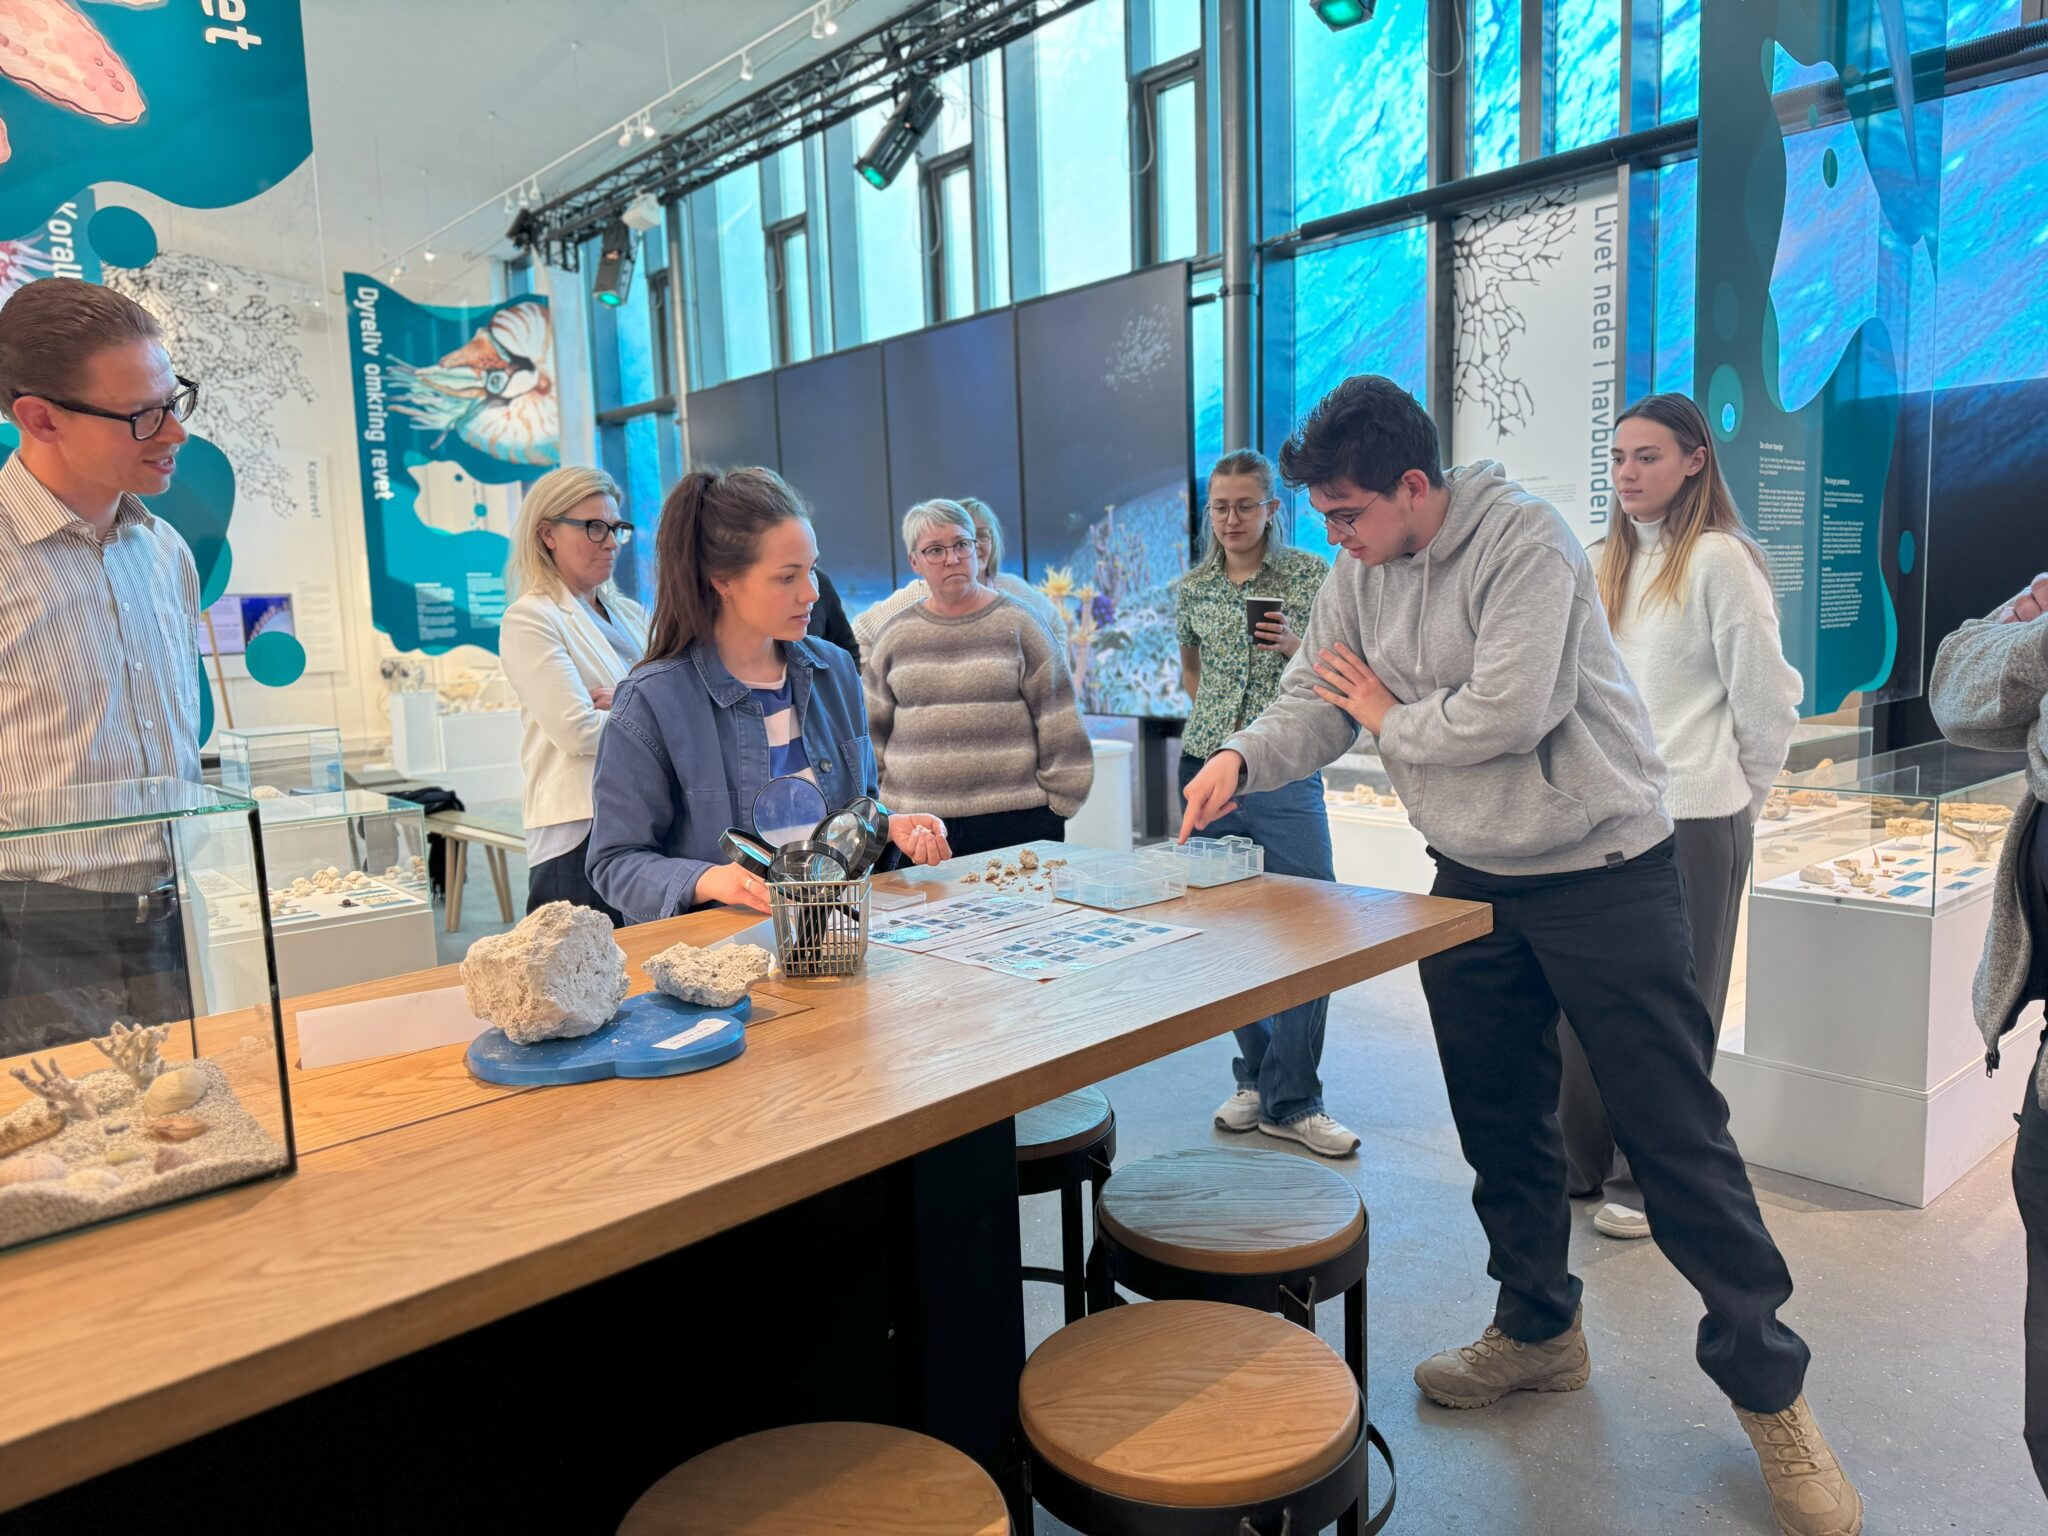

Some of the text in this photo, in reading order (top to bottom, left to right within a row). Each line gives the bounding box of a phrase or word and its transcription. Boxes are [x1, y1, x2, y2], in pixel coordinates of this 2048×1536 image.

[353, 287, 395, 500] Dyreliv omkring revet
[1589, 203, 1618, 524] Livet nede i havbunden
[307, 460, 321, 519] Koralrevet
